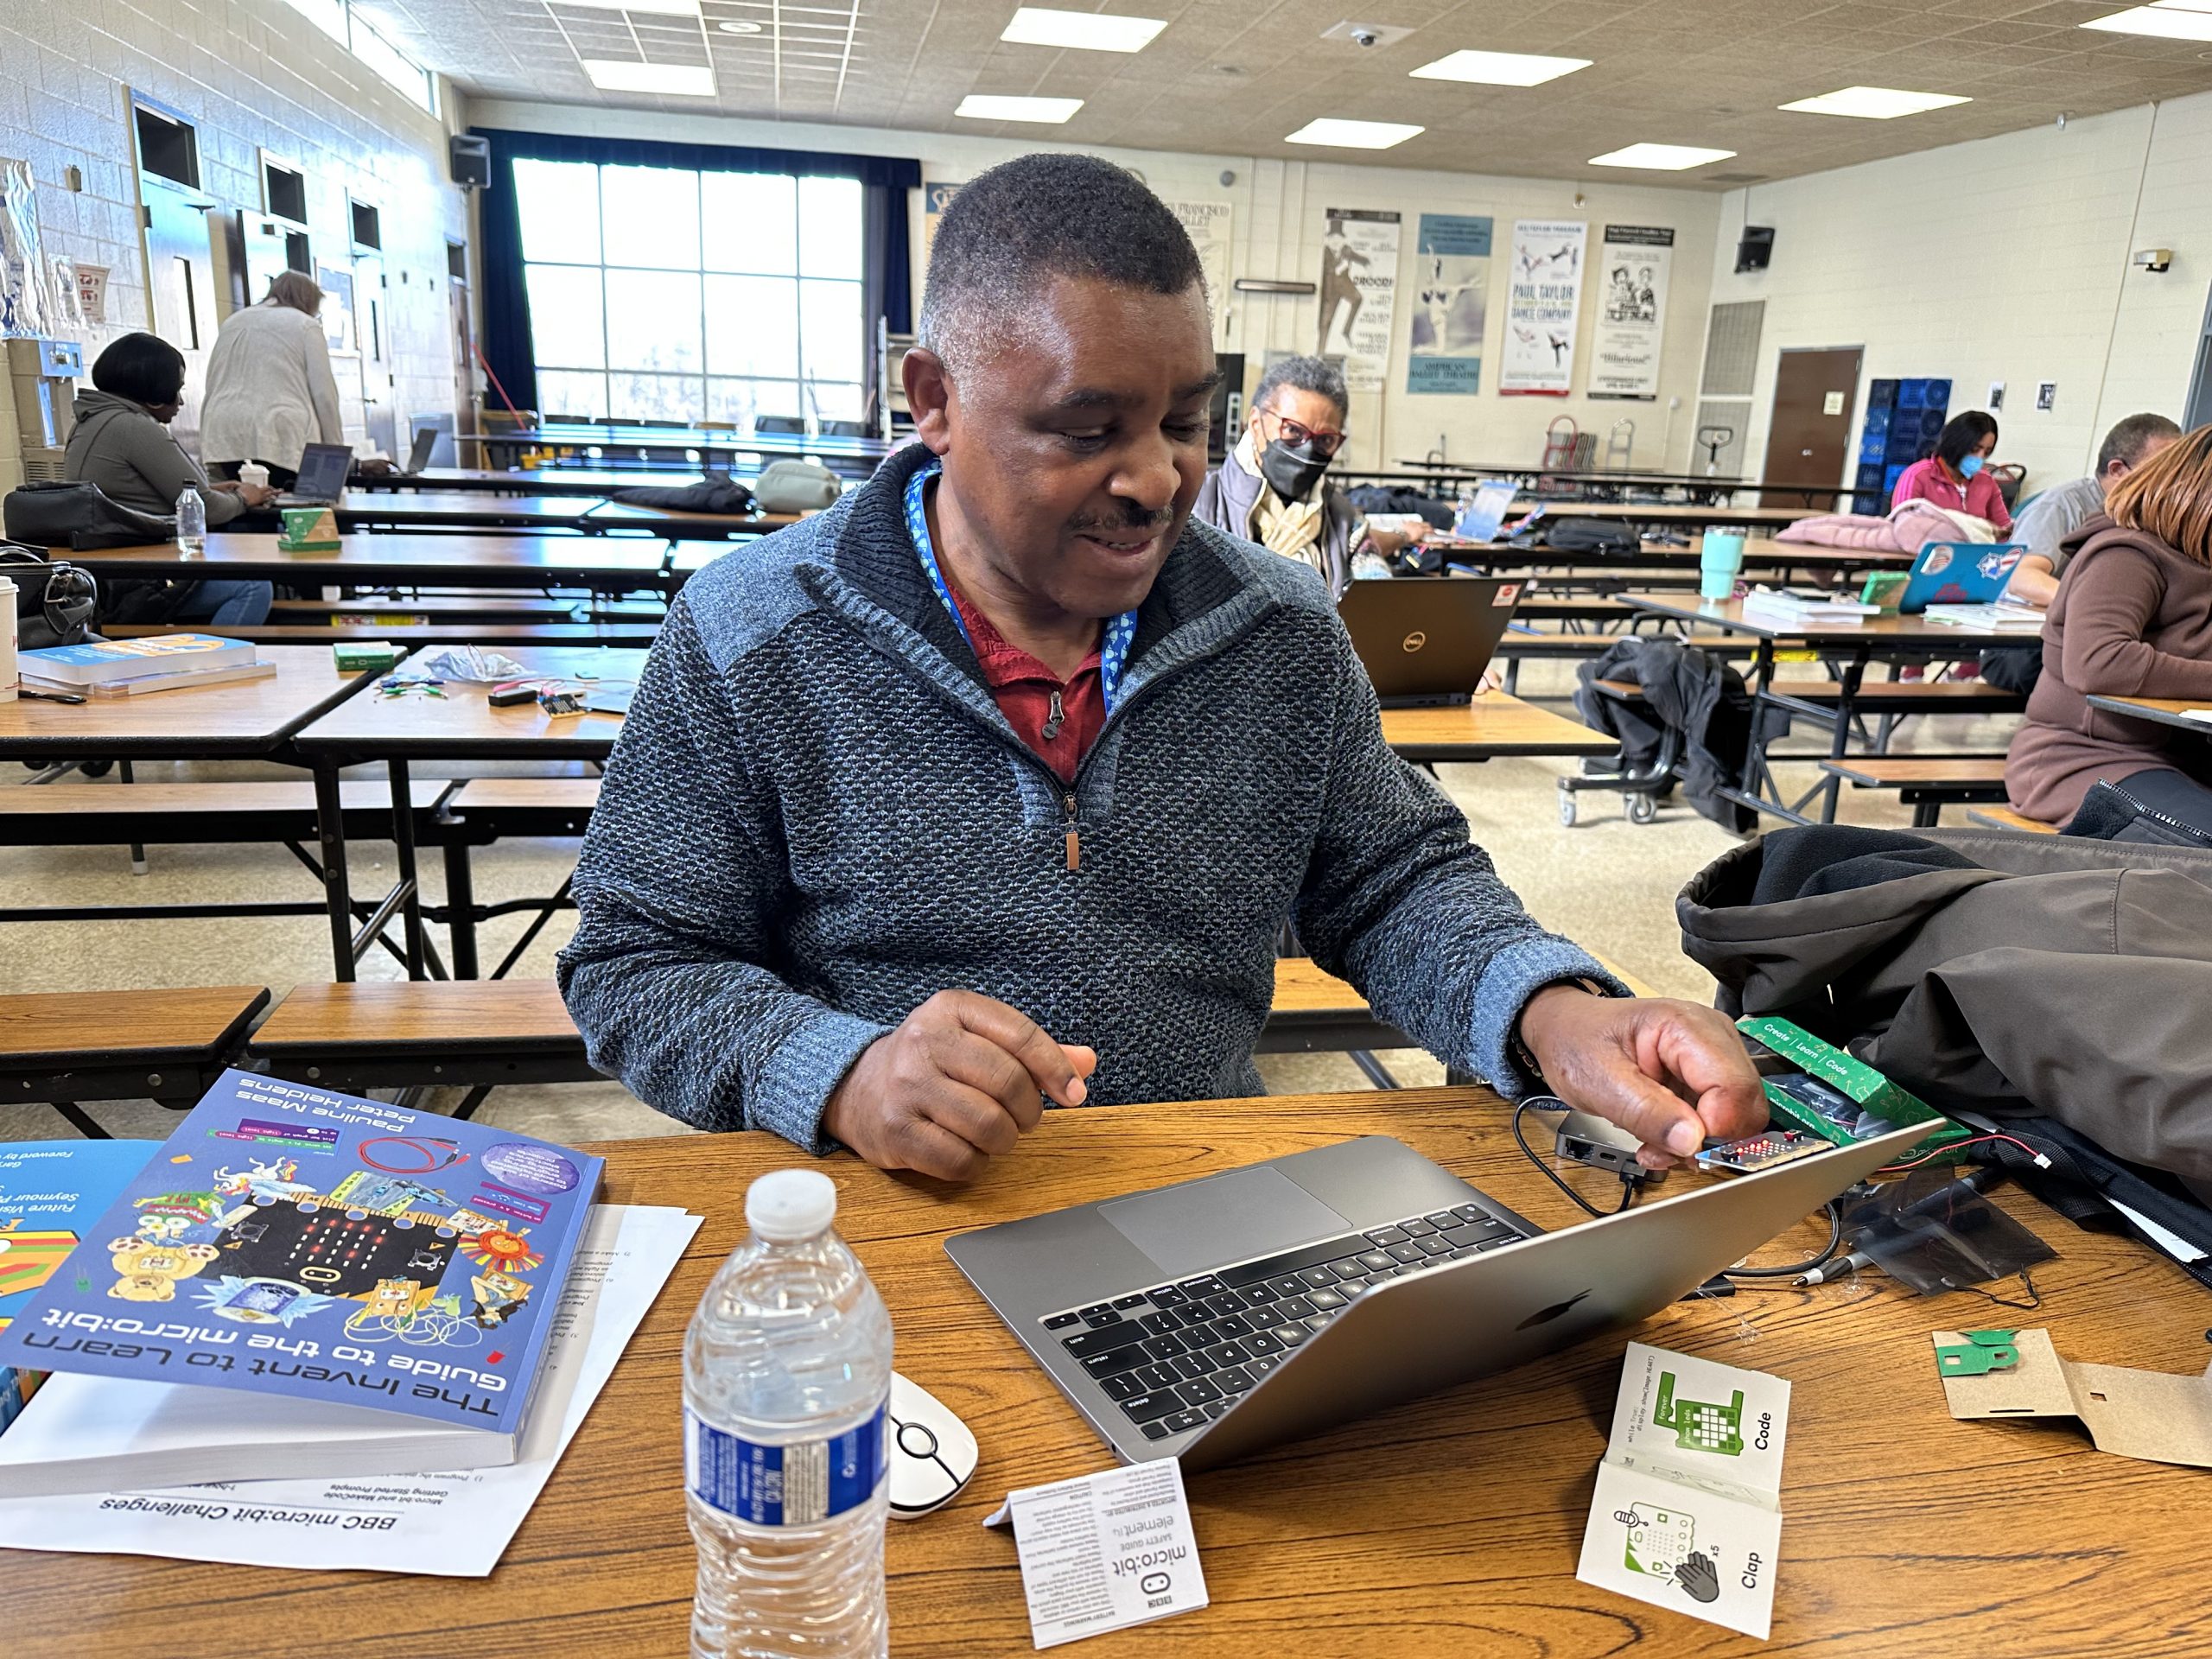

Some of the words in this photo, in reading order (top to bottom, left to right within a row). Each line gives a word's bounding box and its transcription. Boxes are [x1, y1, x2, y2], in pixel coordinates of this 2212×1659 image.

[1513, 283, 1535, 299] PAUL
[1539, 284, 1574, 300] TAYLOR
[1511, 308, 1535, 319] DANCE
[1537, 308, 1572, 319] COMPANY
[1424, 362, 1465, 371] AMERICAN
[1443, 371, 1478, 379] THEATRE
[1764, 1024, 1789, 1042] Create
[1796, 1043, 1818, 1059] Learn
[1826, 1059, 1848, 1076] Code
[238, 1077, 342, 1109] Heldens
[235, 1089, 307, 1113] Maas
[346, 1102, 416, 1124] Peter
[1770, 1096, 1815, 1129] microbit.org
[312, 1106, 405, 1134] Pauline
[506, 1151, 559, 1169] electronics
[516, 1149, 556, 1163] projects
[486, 1163, 518, 1174] simple
[530, 1175, 567, 1189] Dozens
[13, 1192, 79, 1202] Seymour
[0, 1205, 23, 1214] Vis
[1369, 1227, 1395, 1236] command
[1184, 1276, 1212, 1287] command
[1153, 1287, 1173, 1296] option
[41, 1308, 239, 1346] micro:bit
[246, 1333, 320, 1359] the
[1068, 1336, 1088, 1348] shift
[21, 1332, 172, 1368] Learn
[332, 1345, 377, 1368] to
[187, 1352, 236, 1373] to
[1088, 1355, 1109, 1365] return
[252, 1357, 400, 1395] Invent
[387, 1353, 508, 1392] Guide
[411, 1382, 499, 1417] The
[1128, 1397, 1149, 1408] delete
[1657, 1395, 1669, 1421] forever
[1682, 1408, 1692, 1425] leds
[1626, 1424, 1636, 1443] while
[1755, 1412, 1771, 1451] Code
[330, 1484, 372, 1493] Prompts
[373, 1486, 410, 1495] Started
[410, 1487, 448, 1497] Getting
[323, 1492, 376, 1503] MakeCode
[399, 1496, 443, 1506] Micro:bit
[1069, 1491, 1092, 1501] CAUTION
[1151, 1497, 1176, 1508] IMPORTED
[99, 1498, 230, 1519] Challenges
[1115, 1503, 1147, 1515] DISTRIBUTED
[232, 1508, 339, 1528] micro:bit
[342, 1516, 398, 1530] BBC
[1120, 1538, 1144, 1552] GUIDE
[1146, 1533, 1173, 1545] SAFETY
[1710, 1545, 1720, 1557] x5
[1112, 1546, 1186, 1577] micro:bit
[1741, 1551, 1763, 1589] Clap
[1063, 1615, 1092, 1627] WARNINGS
[1093, 1610, 1116, 1621] BATTERY
